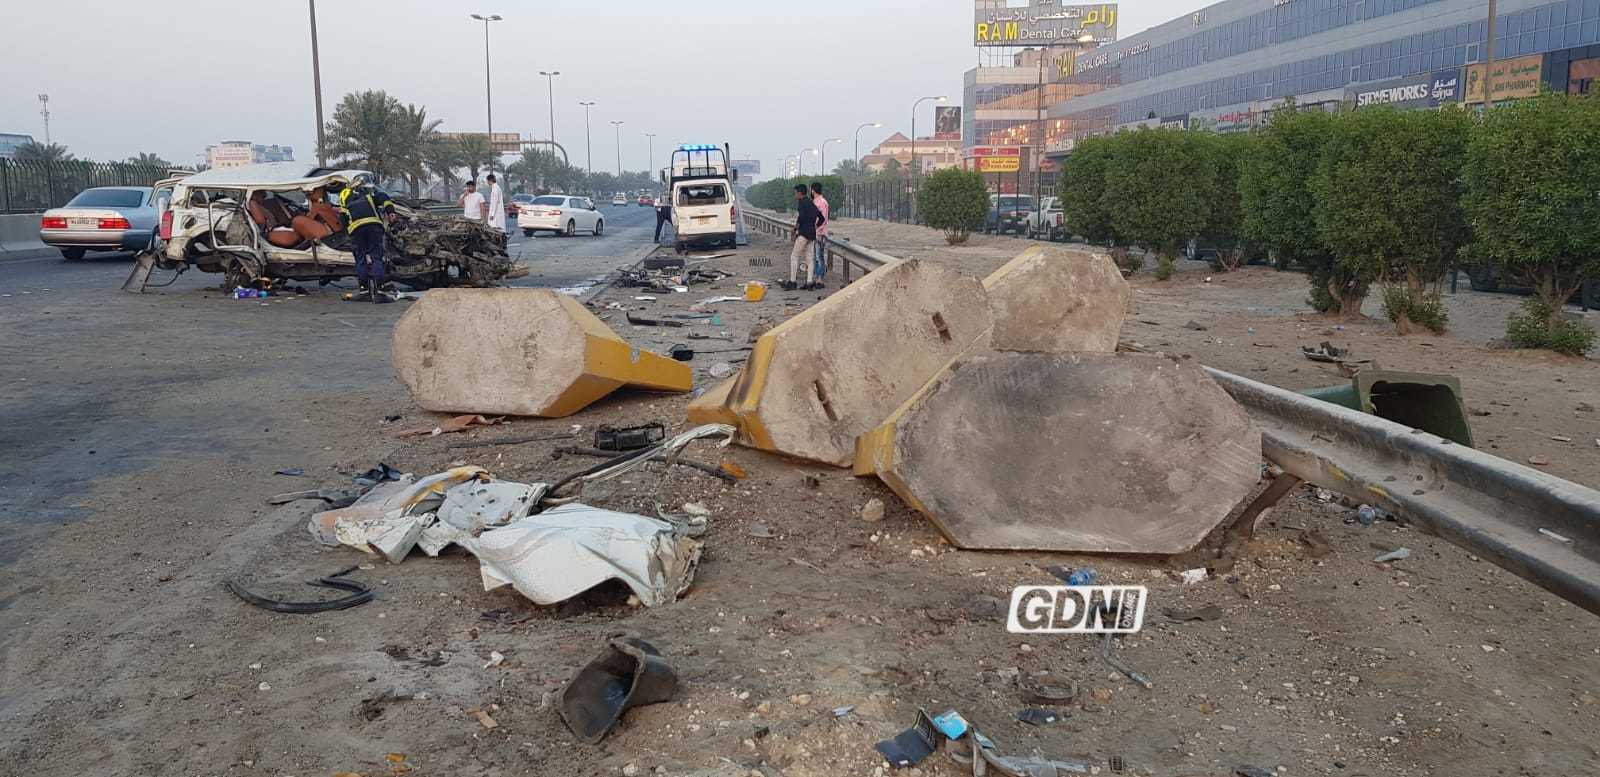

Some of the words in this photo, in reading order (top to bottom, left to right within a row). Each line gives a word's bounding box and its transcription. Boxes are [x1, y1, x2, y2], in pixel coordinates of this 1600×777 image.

[1081, 5, 1116, 28] رام
[976, 23, 1019, 41] RAM
[1020, 28, 1056, 39] Dental
